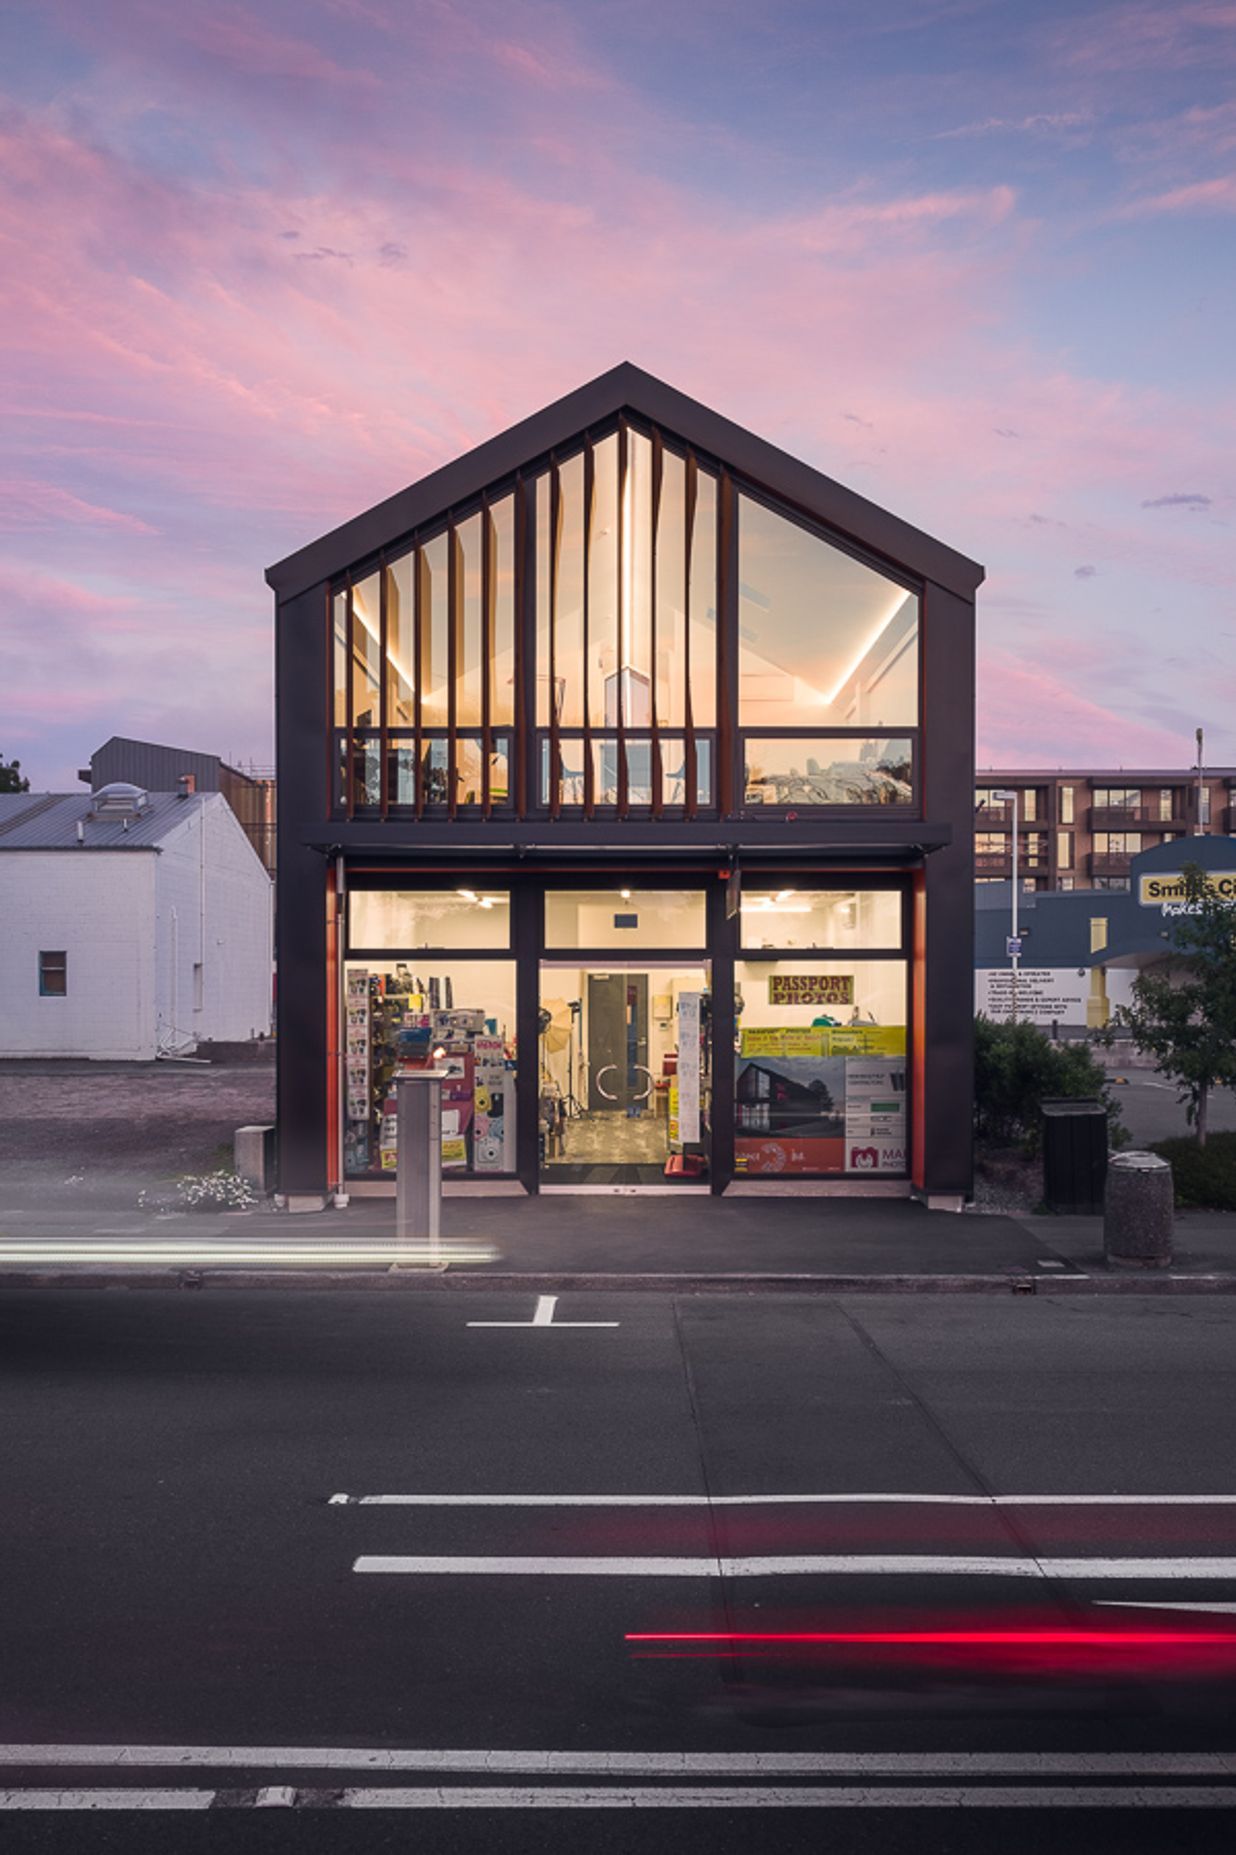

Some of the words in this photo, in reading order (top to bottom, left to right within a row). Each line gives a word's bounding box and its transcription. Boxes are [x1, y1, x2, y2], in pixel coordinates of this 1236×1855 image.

[1148, 879, 1215, 897] Smis
[773, 976, 849, 991] PASSPORT
[773, 991, 849, 1004] PHOTOS
[881, 1149, 905, 1160] MA
